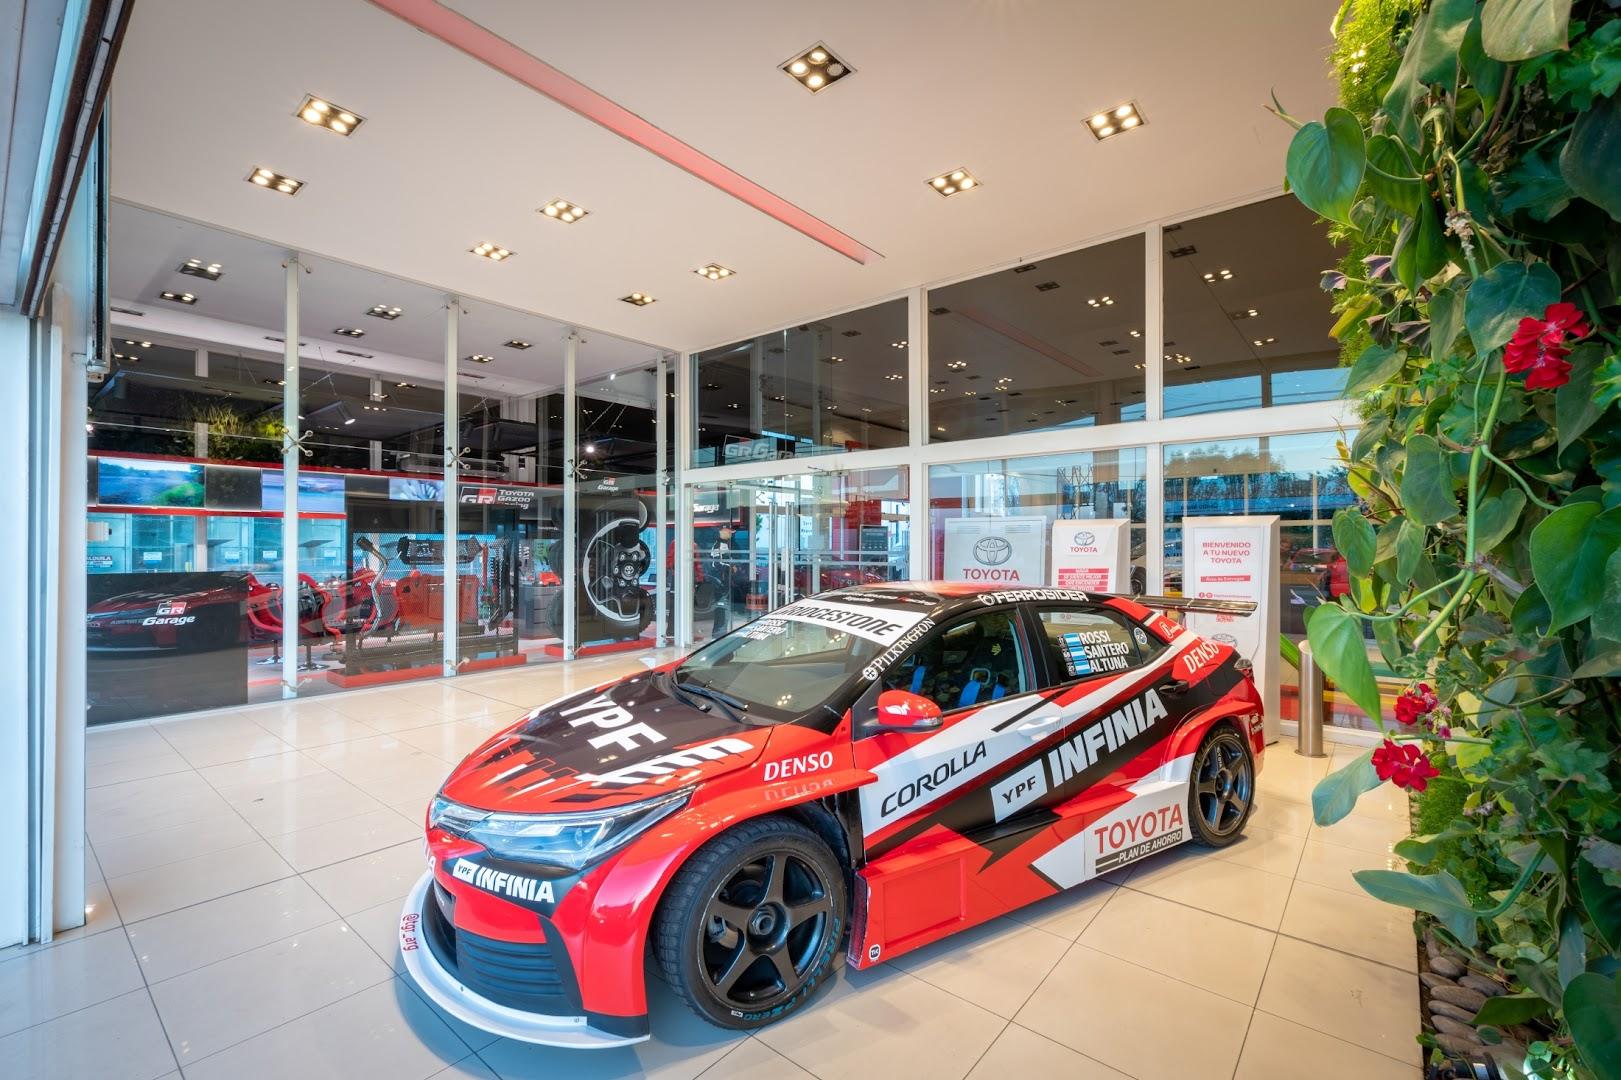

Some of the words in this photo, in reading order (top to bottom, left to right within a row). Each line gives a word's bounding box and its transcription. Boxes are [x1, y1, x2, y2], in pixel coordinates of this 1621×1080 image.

[498, 489, 535, 497] TOYOTA
[963, 568, 1020, 581] TOYOTA
[993, 589, 1089, 603] FERROSIDER
[142, 615, 196, 626] Garage
[872, 617, 936, 674] PILKINGTON
[1080, 630, 1111, 645] ROSSI
[1084, 642, 1129, 659] SANTERO
[1089, 656, 1129, 673] ALTUNA
[1183, 641, 1220, 674] DENSO
[559, 695, 668, 752] YPF
[1001, 775, 1037, 804] YPF
[1047, 688, 1168, 788] INFINIA
[763, 750, 834, 781] DENSO
[880, 740, 987, 818] COROLLA
[1094, 803, 1184, 854] TOYOTA
[1117, 846, 1140, 864] PLAN
[1140, 843, 1151, 855] DE
[1151, 830, 1182, 851] AHORRO
[457, 864, 473, 876] YPF
[475, 866, 555, 904] INFINIA
